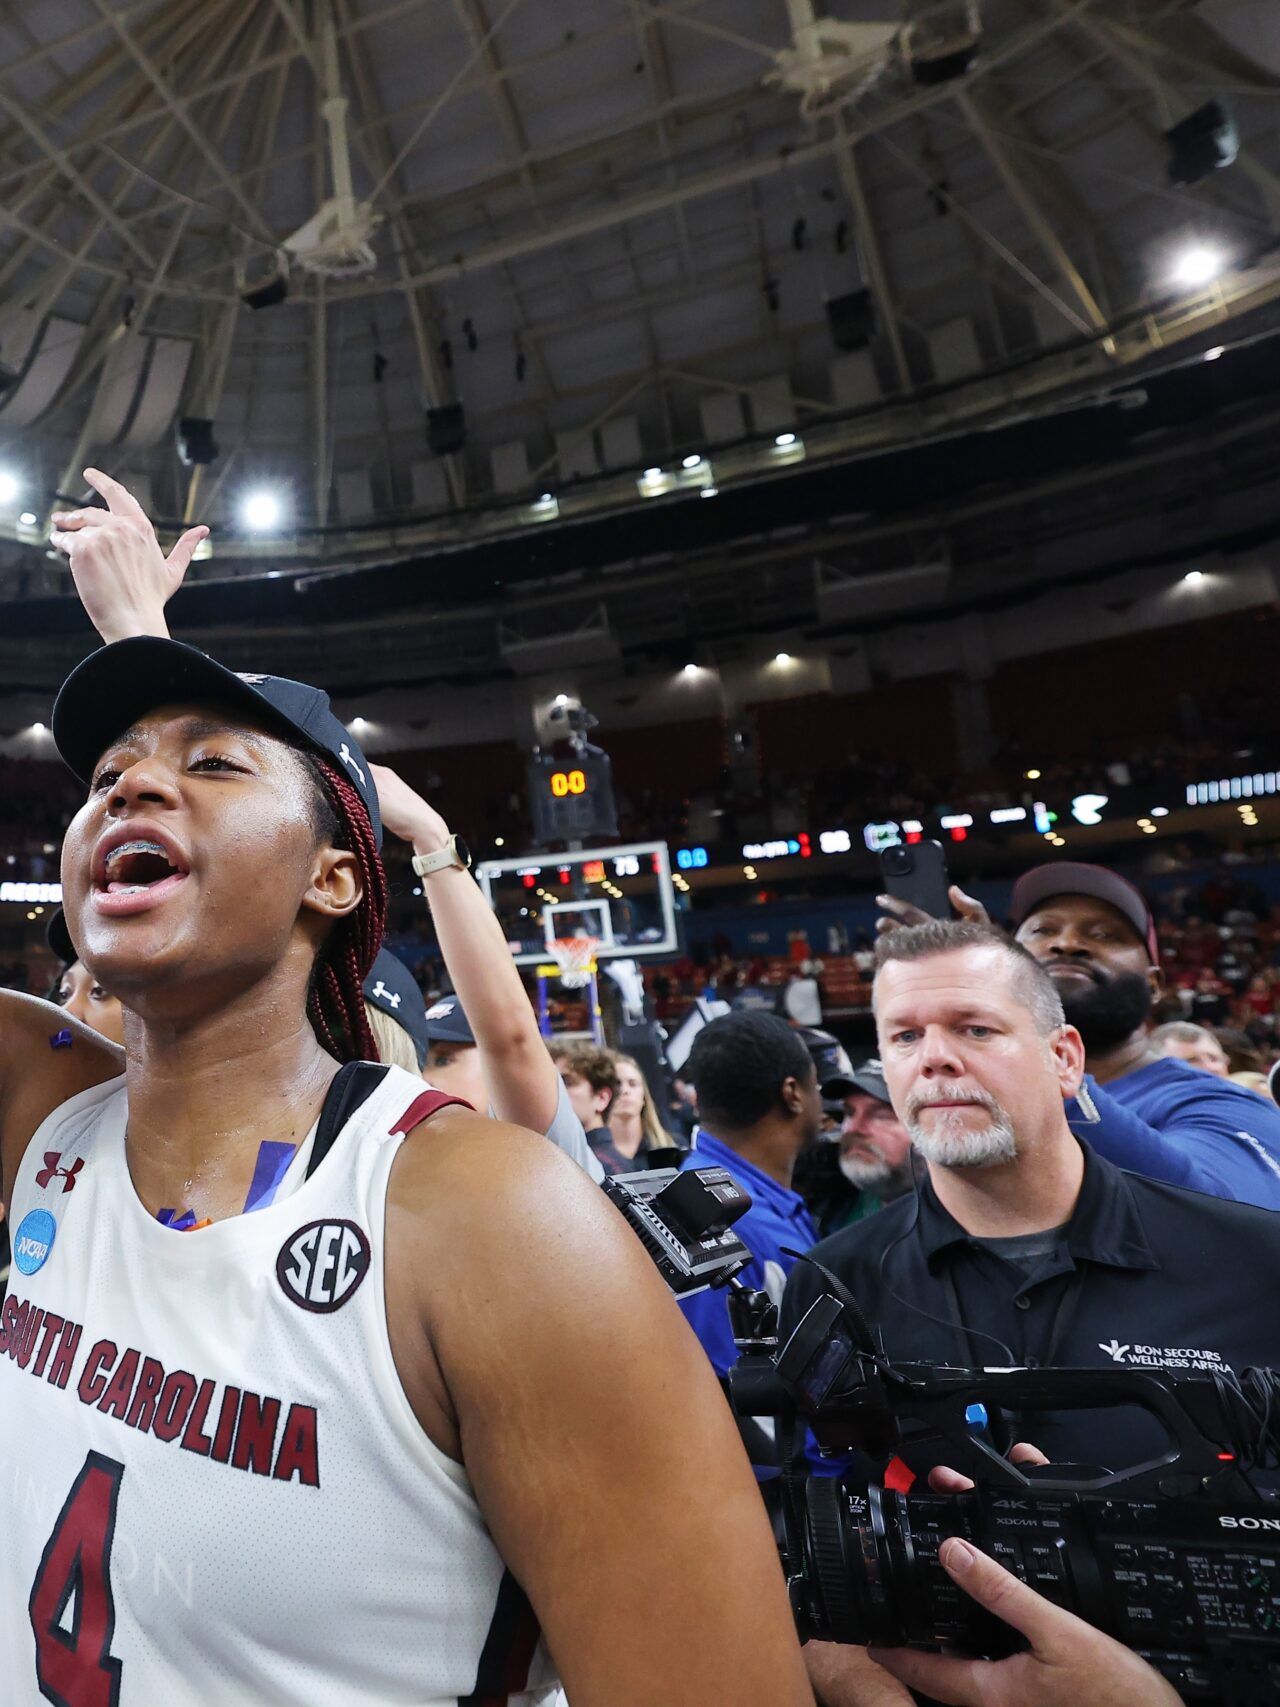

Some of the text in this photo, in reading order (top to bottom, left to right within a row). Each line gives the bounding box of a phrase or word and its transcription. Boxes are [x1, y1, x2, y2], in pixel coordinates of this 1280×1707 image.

[17, 1236, 49, 1261] NCAA
[284, 1224, 362, 1303] SEC
[1127, 1354, 1235, 1374] WELLNESS ARENA
[1134, 1344, 1222, 1362] BON SECOURS
[77, 1338, 320, 1489] CAROLINA
[29, 1449, 124, 1707] 4
